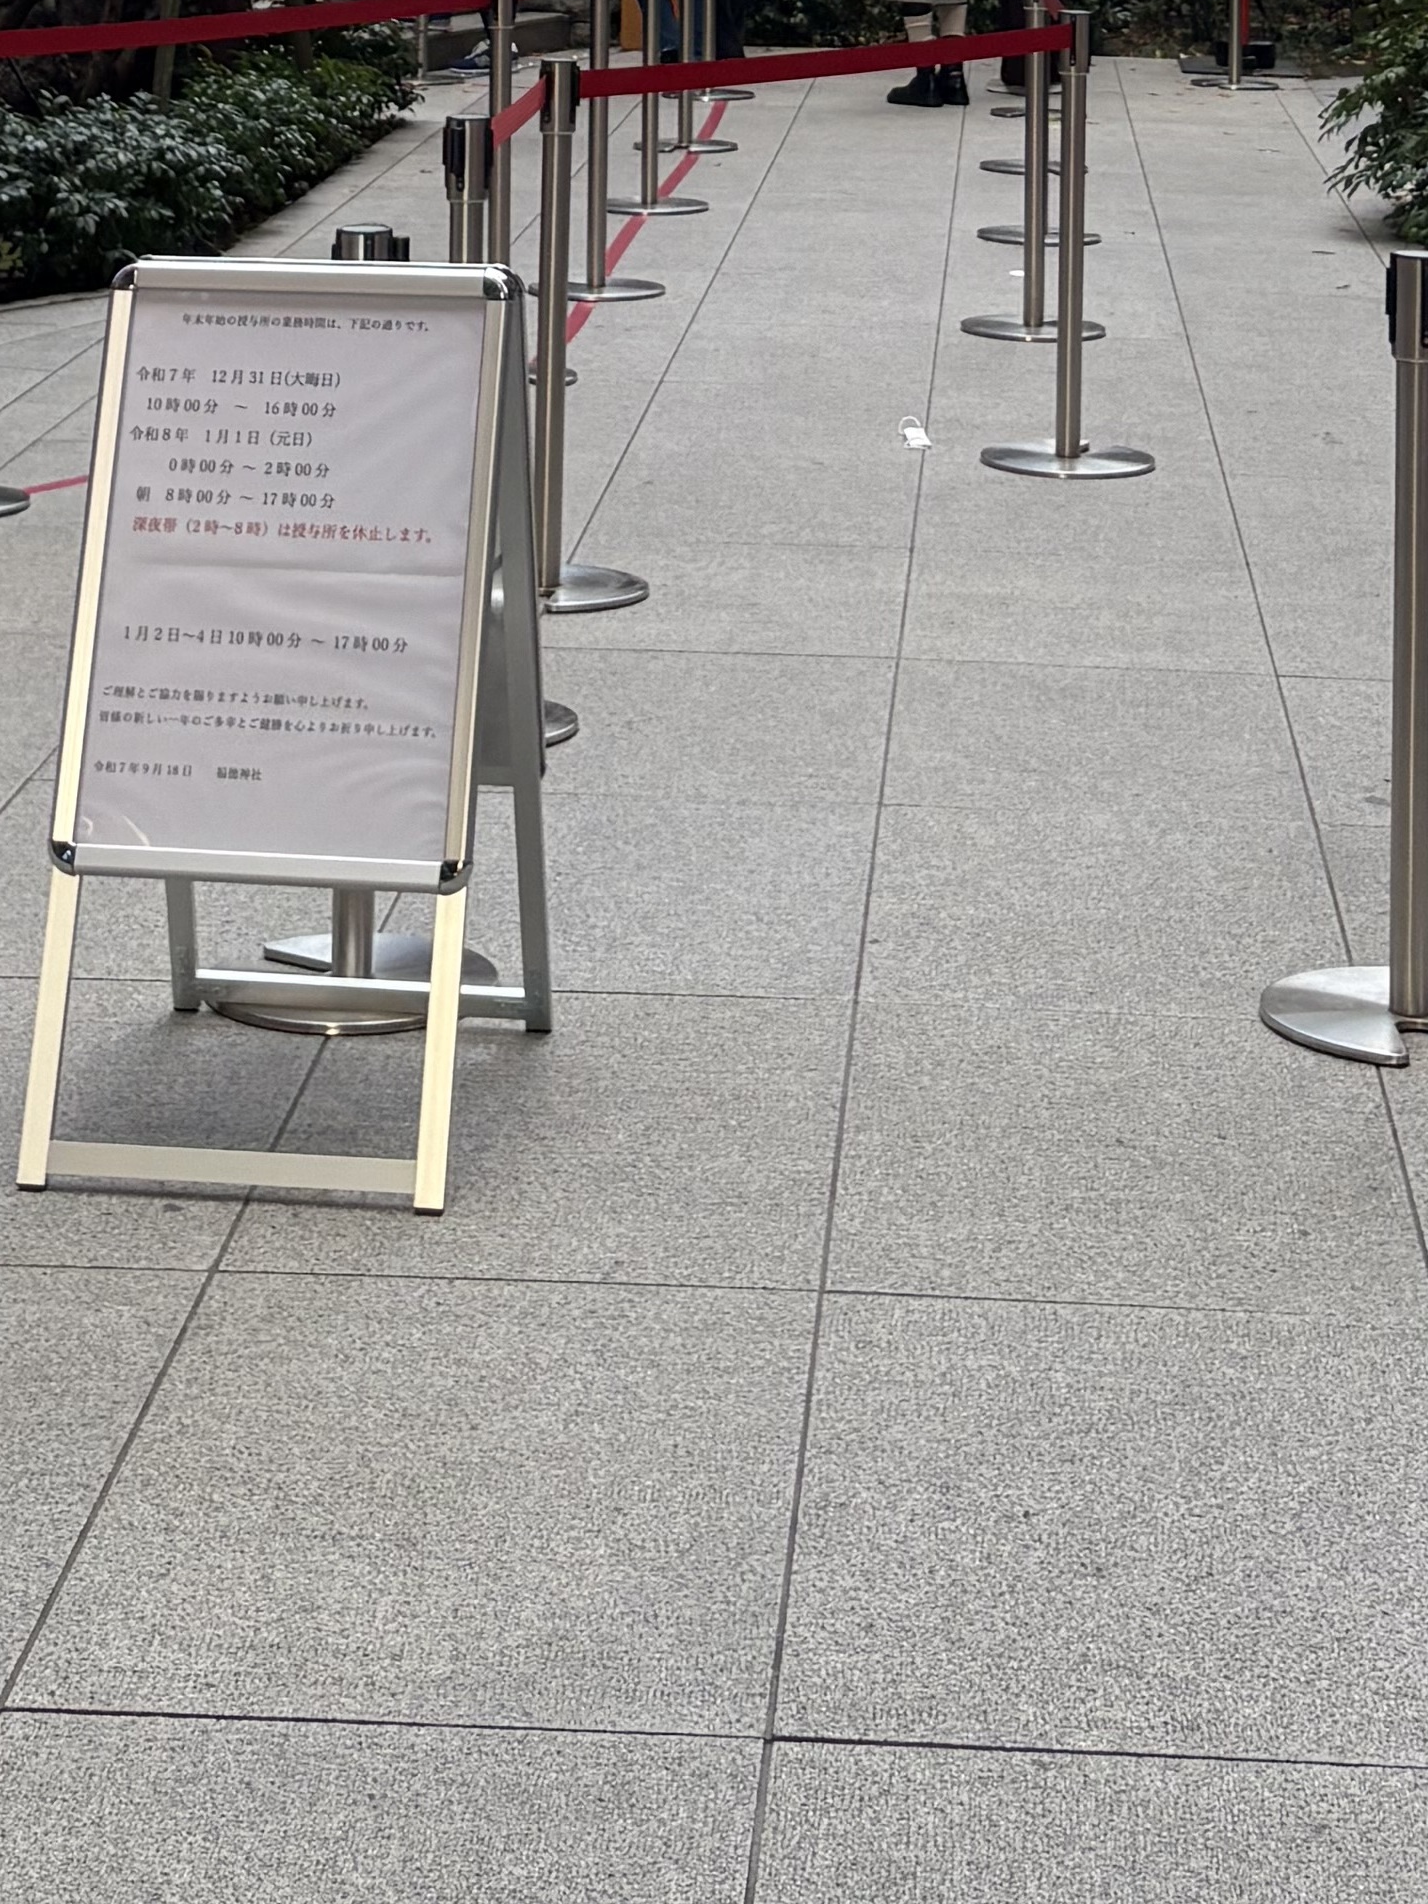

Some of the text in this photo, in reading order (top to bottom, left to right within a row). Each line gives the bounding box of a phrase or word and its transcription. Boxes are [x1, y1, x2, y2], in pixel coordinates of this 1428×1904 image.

[146, 397, 219, 414] 10時00分
[264, 400, 337, 418] 16時00分
[129, 425, 189, 442] 令和8年
[168, 457, 234, 475] 0時00分
[263, 461, 330, 478] 2時00分
[165, 488, 232, 504] 8時00分
[262, 492, 335, 509] 17時00分
[334, 635, 408, 654] 17時00分
